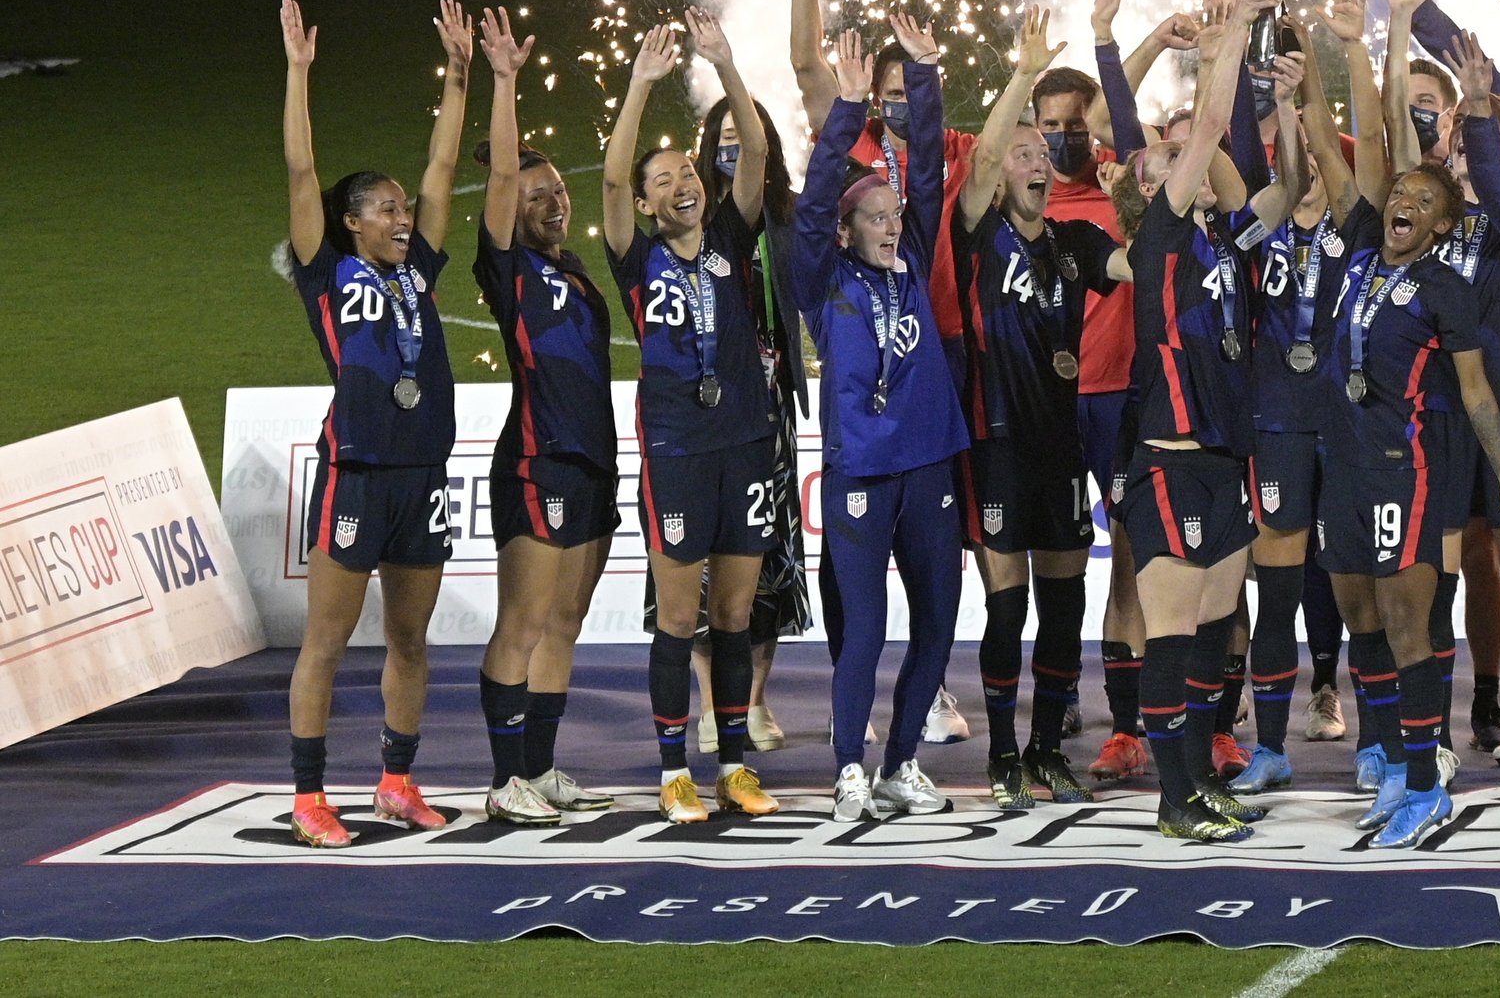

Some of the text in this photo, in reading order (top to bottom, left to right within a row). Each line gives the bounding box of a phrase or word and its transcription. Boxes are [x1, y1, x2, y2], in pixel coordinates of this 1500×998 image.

[1322, 234, 1340, 246] USA
[706, 254, 720, 269] USA
[1452, 241, 1461, 264] 2021
[1002, 252, 1037, 303] 14
[1259, 251, 1289, 298] 13
[1398, 283, 1416, 294] USA
[339, 283, 384, 324] 20
[646, 280, 686, 327] 23
[1360, 302, 1378, 328] 2021
[115, 465, 184, 506] PRESENTED BY
[1262, 489, 1279, 499] USA
[548, 504, 563, 515] USA
[848, 494, 865, 504] USA
[338, 522, 356, 534] USA
[665, 520, 683, 530] USA
[984, 512, 1001, 521] USA
[1372, 502, 1402, 548] 19
[1185, 524, 1201, 533] USA
[69, 516, 122, 591] CUP
[131, 515, 219, 594] VISA
[492, 884, 1334, 918] PRESENTED BY
